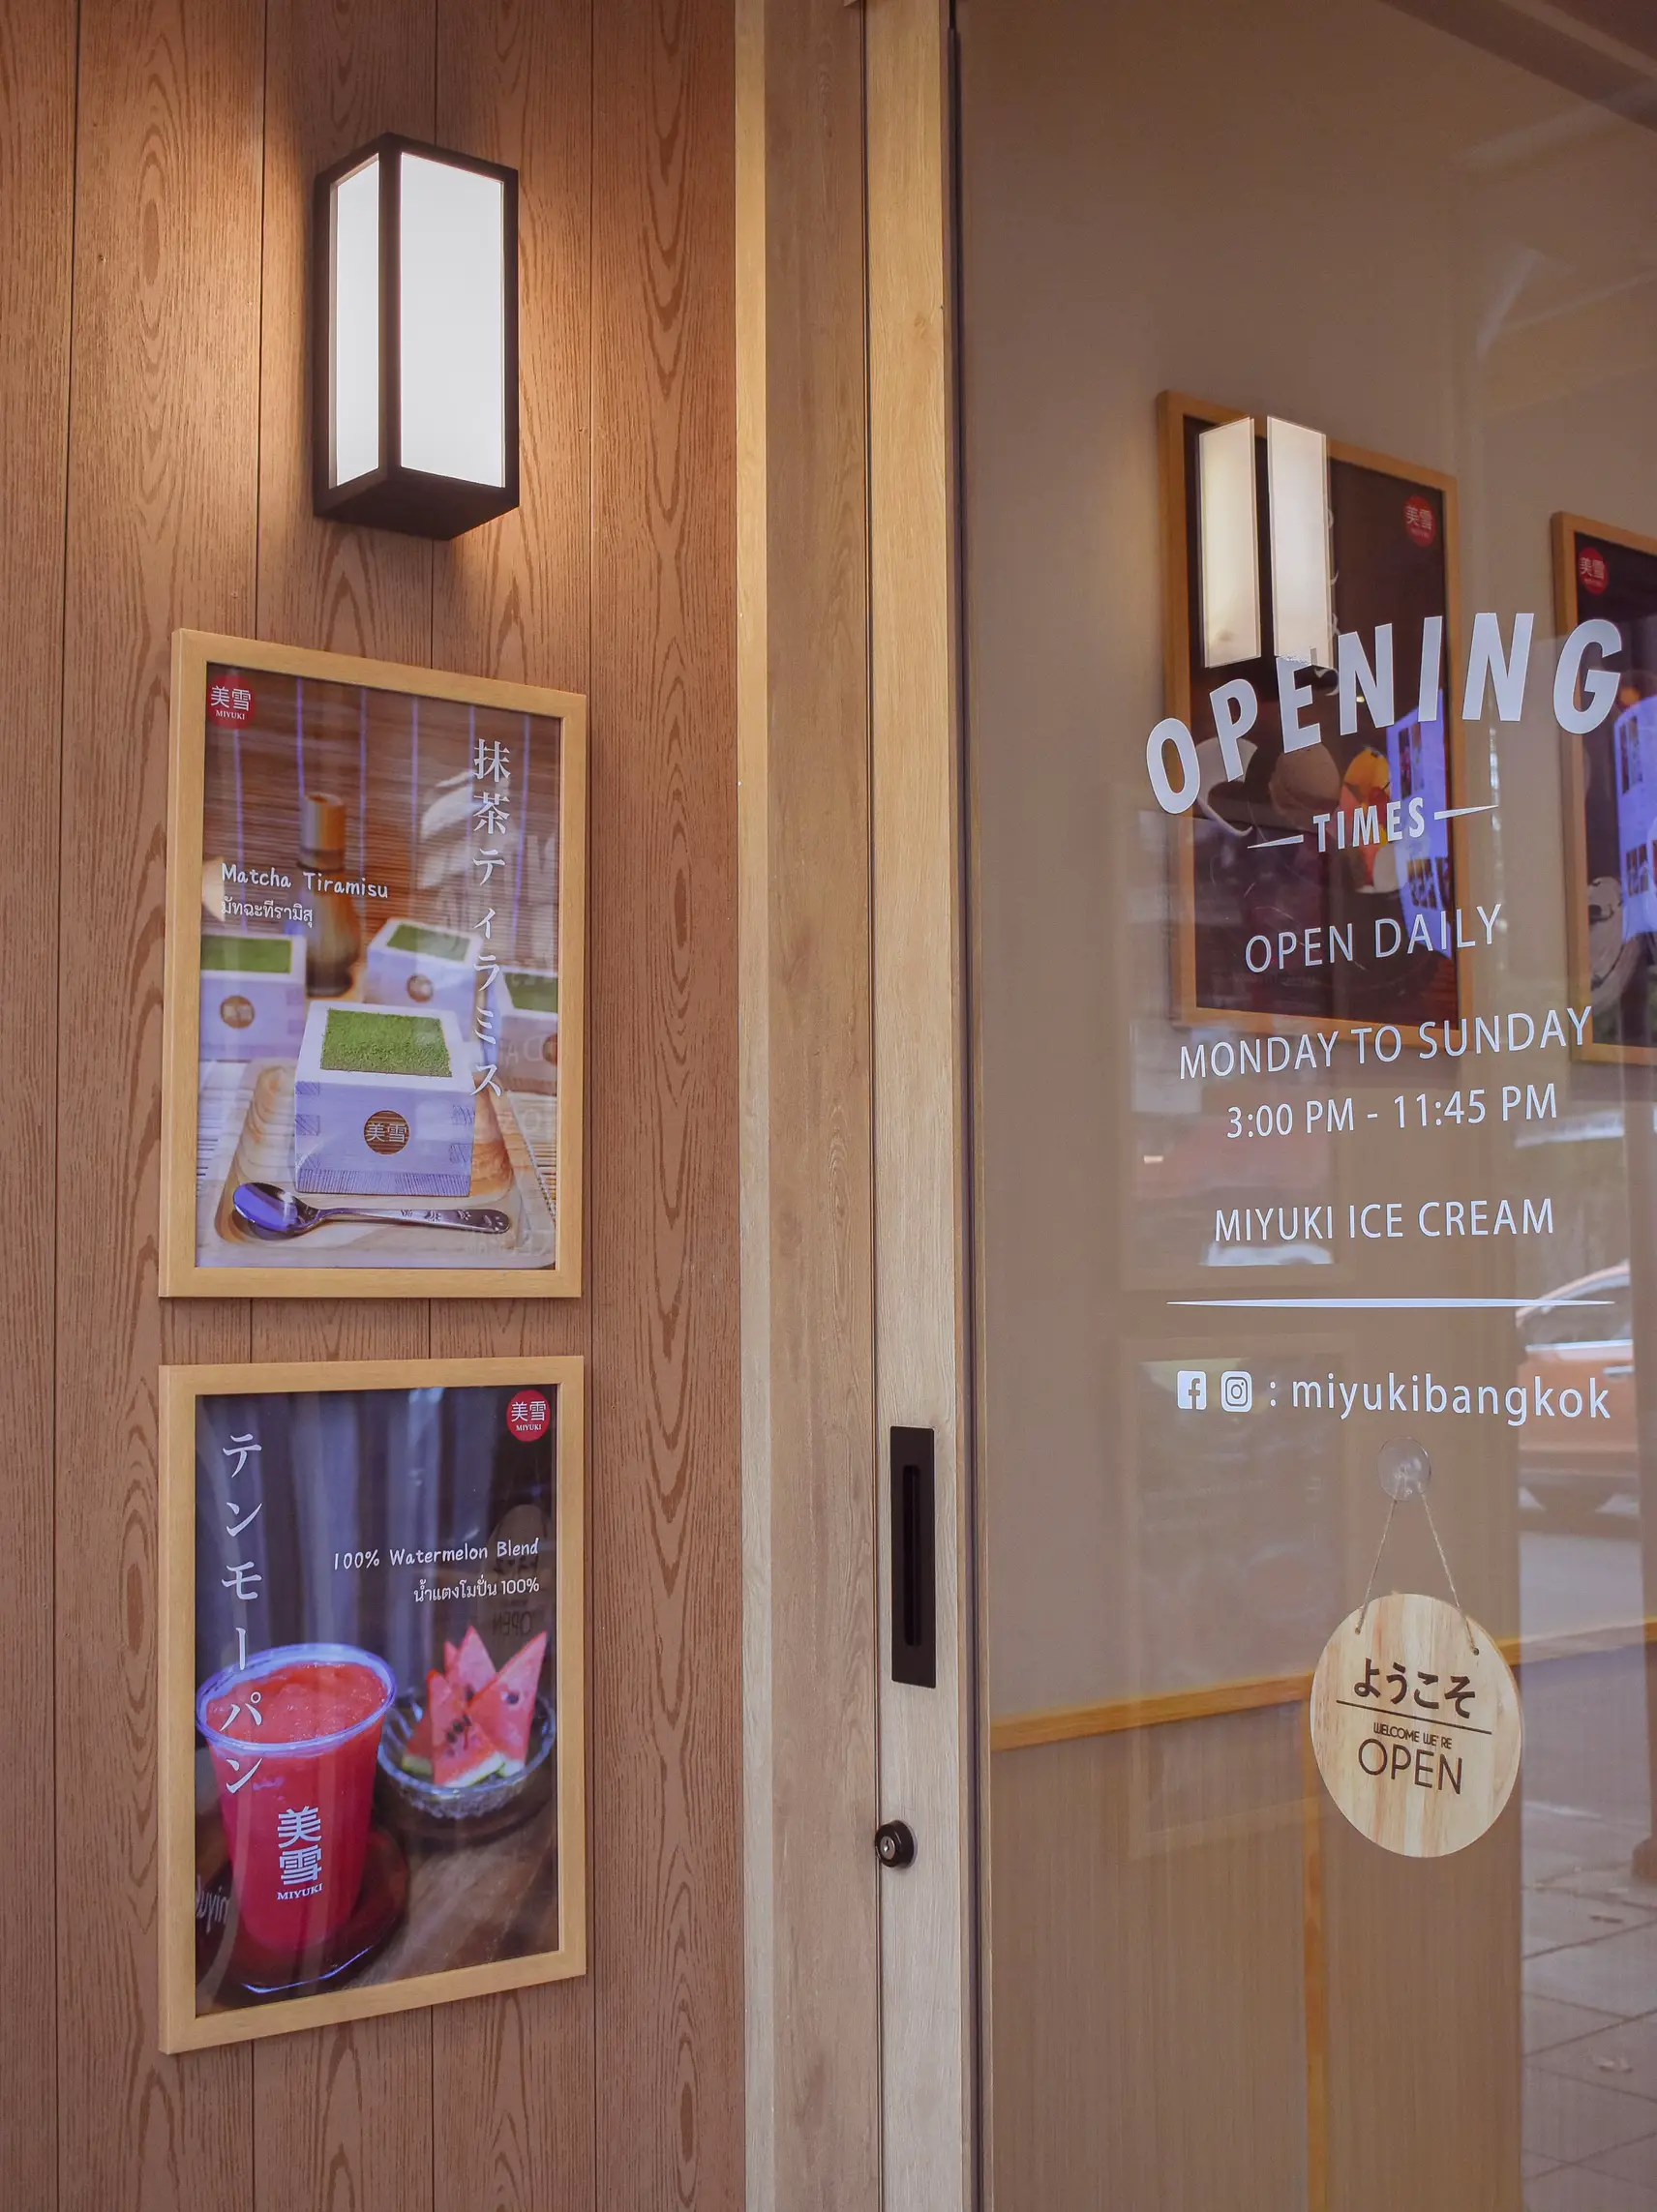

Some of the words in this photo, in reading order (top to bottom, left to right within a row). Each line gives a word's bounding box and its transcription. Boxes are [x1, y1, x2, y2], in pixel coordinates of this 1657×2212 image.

[210, 685, 252, 711] 美雪
[216, 709, 245, 720] MIYUKI
[1146, 613, 1622, 814] OPENING
[1312, 796, 1425, 852] TIMES
[222, 862, 291, 888] Matcha
[303, 871, 388, 899] Tiramisu
[221, 896, 313, 928] มัทฉะทีรามิสุ
[470, 738, 511, 1096] 抹茶ティラミス
[1245, 923, 1353, 973] OPEN
[1374, 904, 1502, 959] DAILY
[1179, 1031, 1339, 1080] MONDAY
[1350, 1025, 1402, 1065] TO
[1418, 1005, 1593, 1060] SUNDAY
[366, 1122, 407, 1143] 美雪
[1226, 1102, 1293, 1139] 3:00
[1307, 1097, 1355, 1133] PM
[1394, 1089, 1486, 1129] 11:45
[1502, 1083, 1557, 1121] PM
[1215, 1206, 1333, 1242] MIYUKI
[1349, 1203, 1402, 1239] ICE
[1418, 1198, 1553, 1238] CREAM
[511, 1400, 546, 1422] 美雪
[1291, 1372, 1611, 1427] miyukibangkok
[334, 1548, 380, 1570] 100%
[389, 1542, 488, 1567] Watermelon
[497, 1538, 539, 1558] Blend
[501, 1577, 539, 1595] 100%
[220, 1433, 262, 1794] テンモーパン
[1354, 1657, 1475, 1719] ようこそ
[1373, 1721, 1420, 1743] WELCOME
[1358, 1738, 1462, 1795] OPEN
[277, 1806, 322, 1885] 美雪
[277, 1883, 323, 1900] MIYUKI
